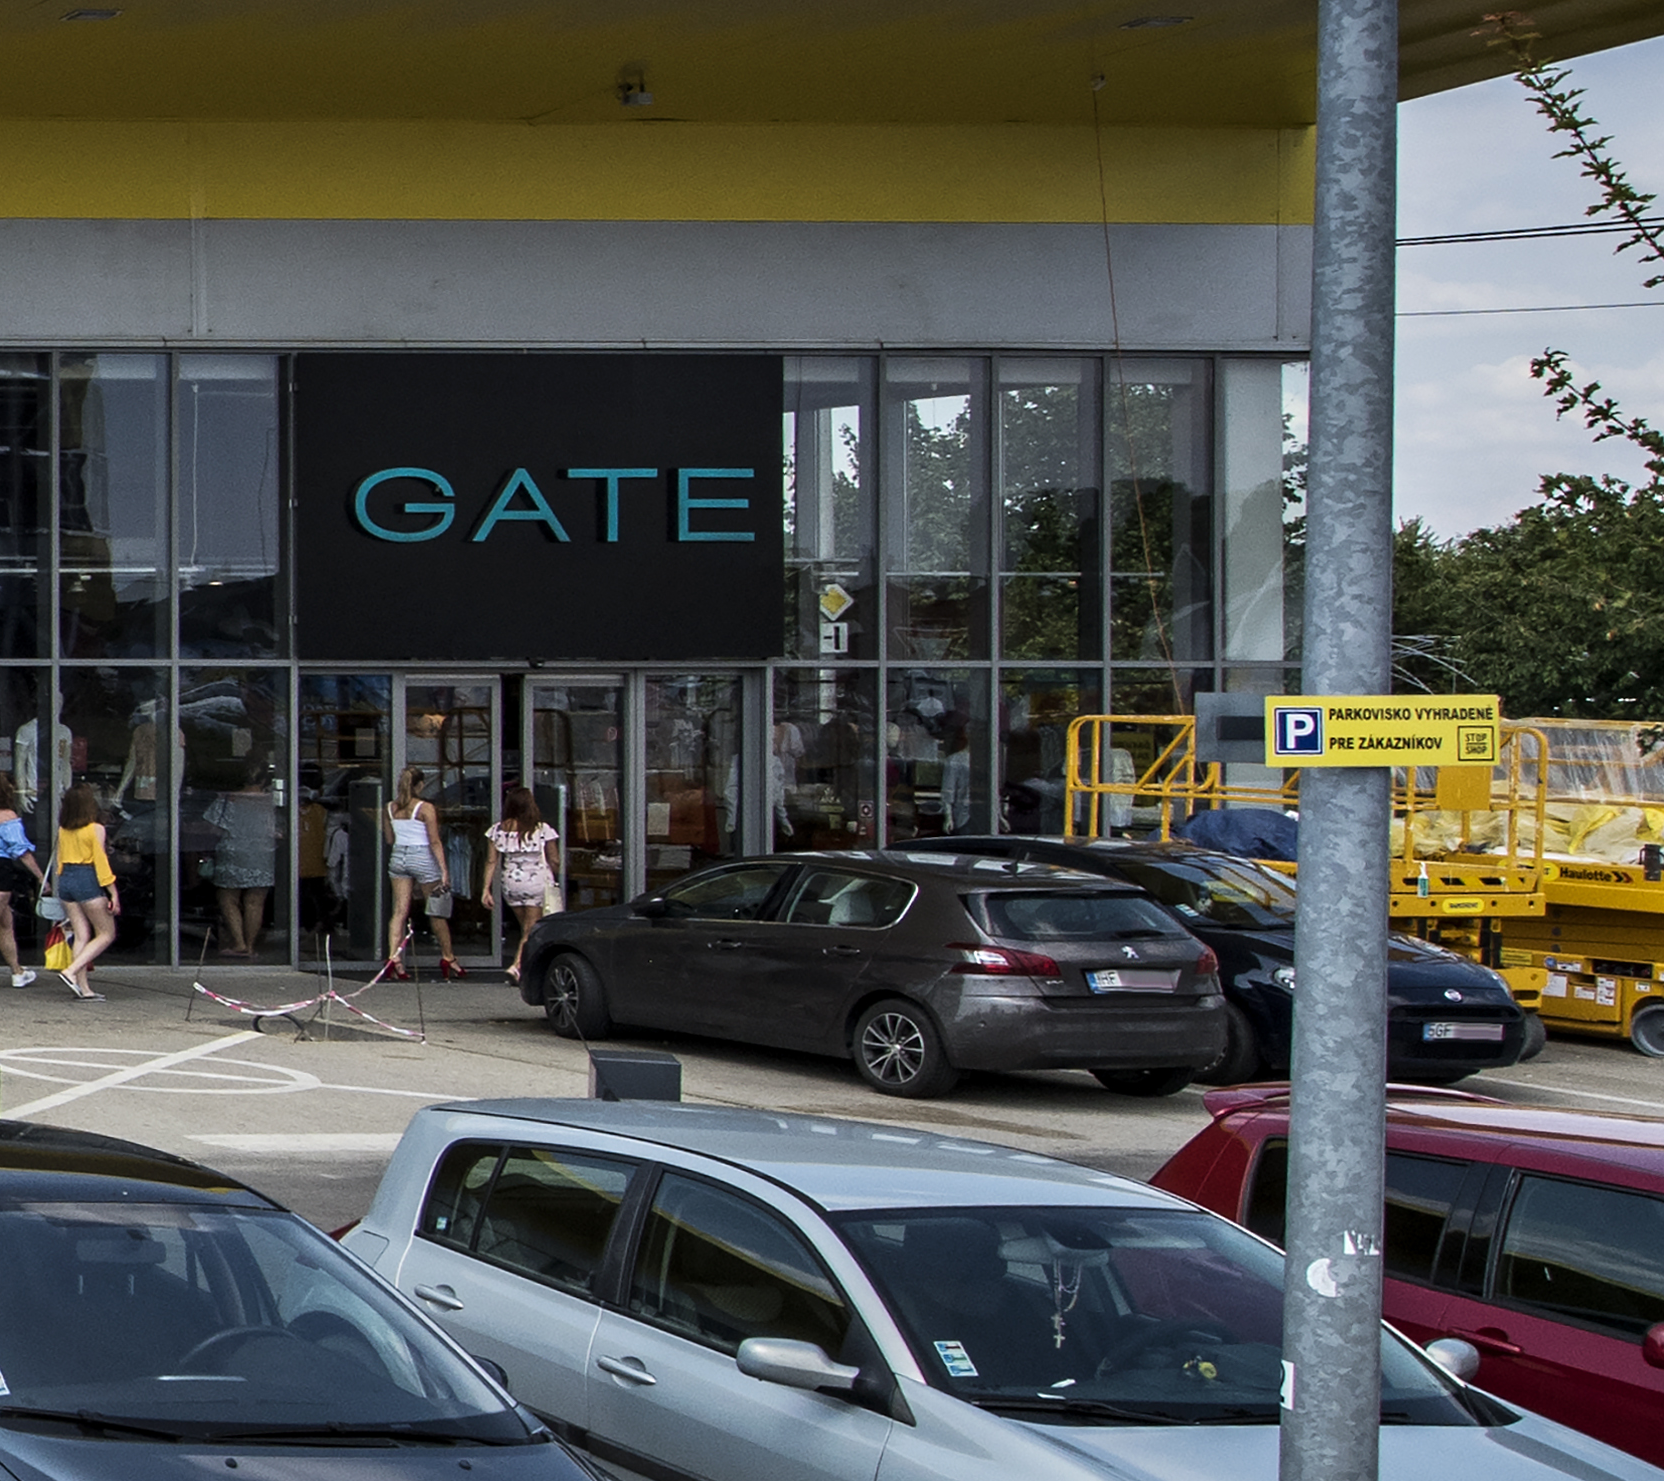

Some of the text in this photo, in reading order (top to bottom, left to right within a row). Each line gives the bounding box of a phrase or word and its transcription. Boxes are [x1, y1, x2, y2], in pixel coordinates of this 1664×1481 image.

[354, 466, 756, 542] GATE
[1329, 704, 1494, 721] PARKOVISKO VYHRADENÉ
[1285, 713, 1315, 750] P
[1465, 733, 1487, 743] STOP
[1329, 733, 1443, 750] PRE ZÁKAZNÍKOV
[1465, 745, 1487, 755] SHOP
[1559, 866, 1613, 883] Haulotte
